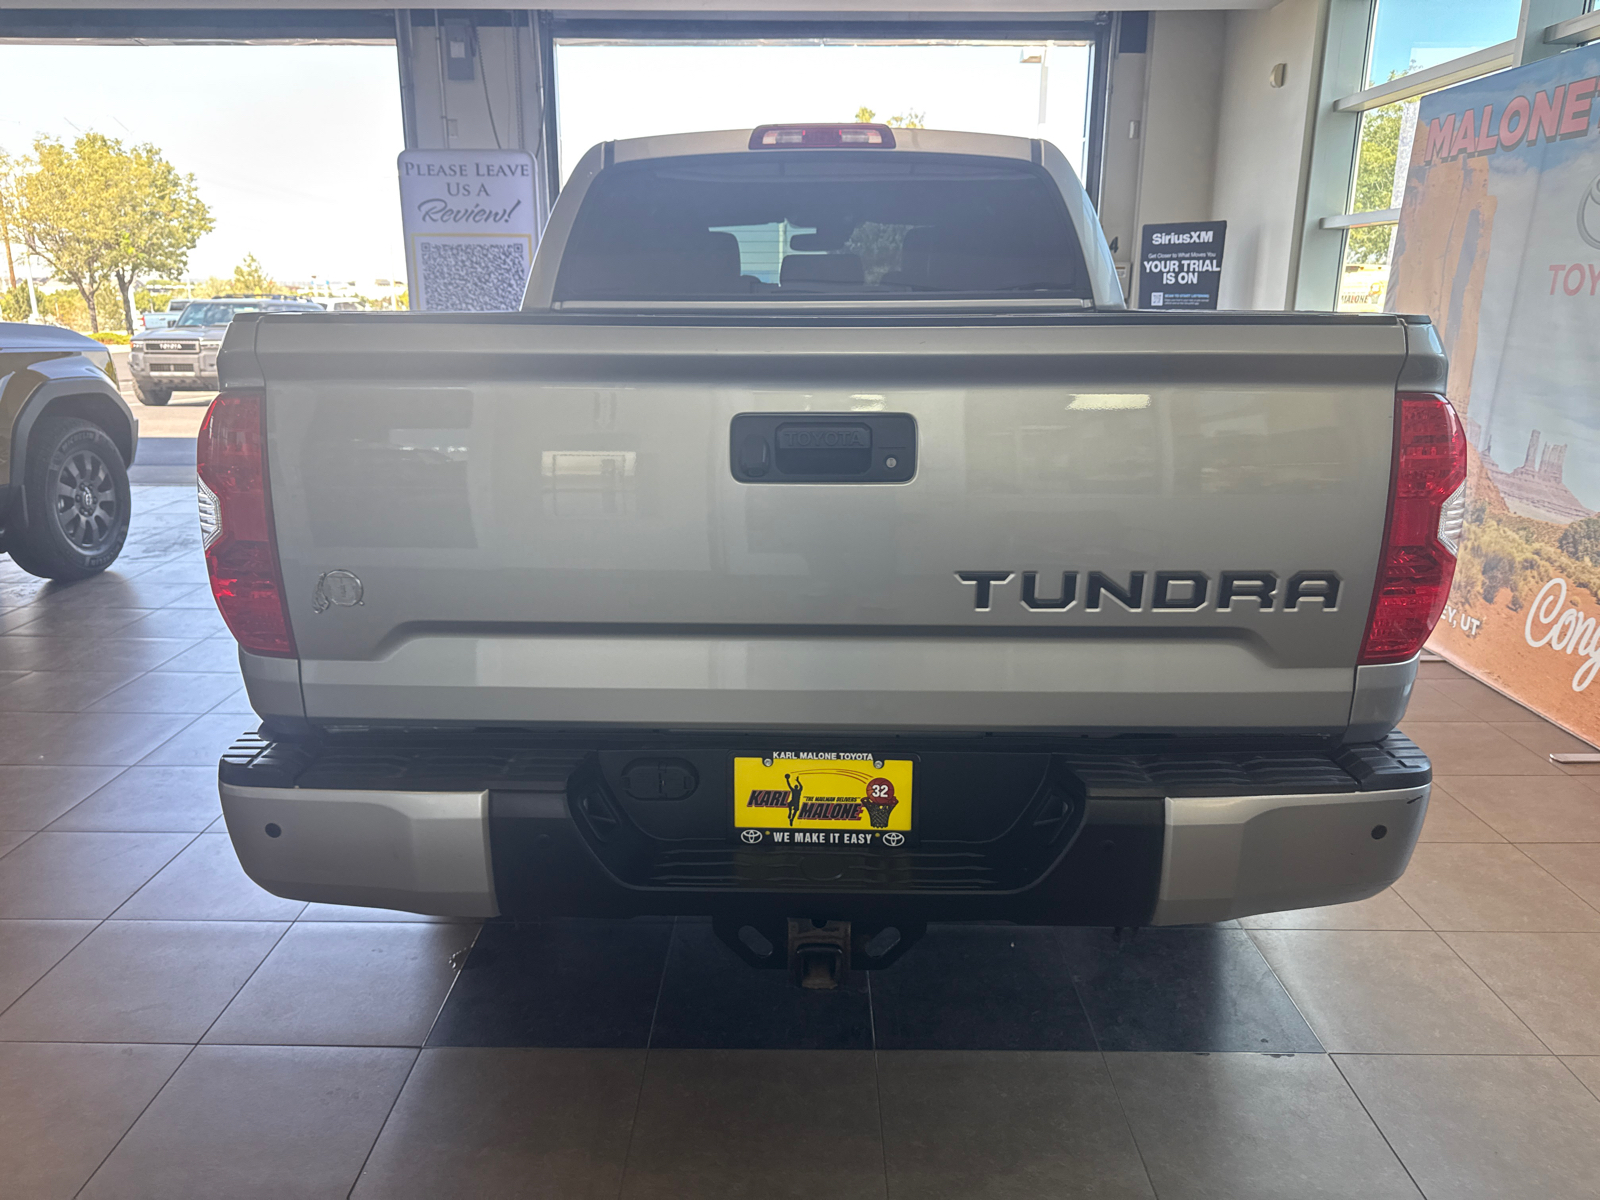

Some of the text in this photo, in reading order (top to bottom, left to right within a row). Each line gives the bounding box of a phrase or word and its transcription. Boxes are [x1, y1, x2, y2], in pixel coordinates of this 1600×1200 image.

[404, 162, 529, 177] PLEASE LEAVE
[476, 183, 491, 197] A
[417, 198, 521, 223] Review!
[1152, 230, 1214, 245] SiriusXM
[1143, 259, 1221, 273] YOUR TRIAL
[1163, 272, 1198, 284] IS ON
[785, 430, 864, 447] TOYOTA
[953, 571, 1343, 613] TUNDRA
[1460, 613, 1480, 635] UT
[773, 751, 874, 761] KARL MALONE TOYOTA
[872, 784, 889, 798] 32
[747, 790, 791, 808] KARL
[798, 802, 864, 821] MALONE
[773, 831, 872, 844] WE MAKE IT EASY
